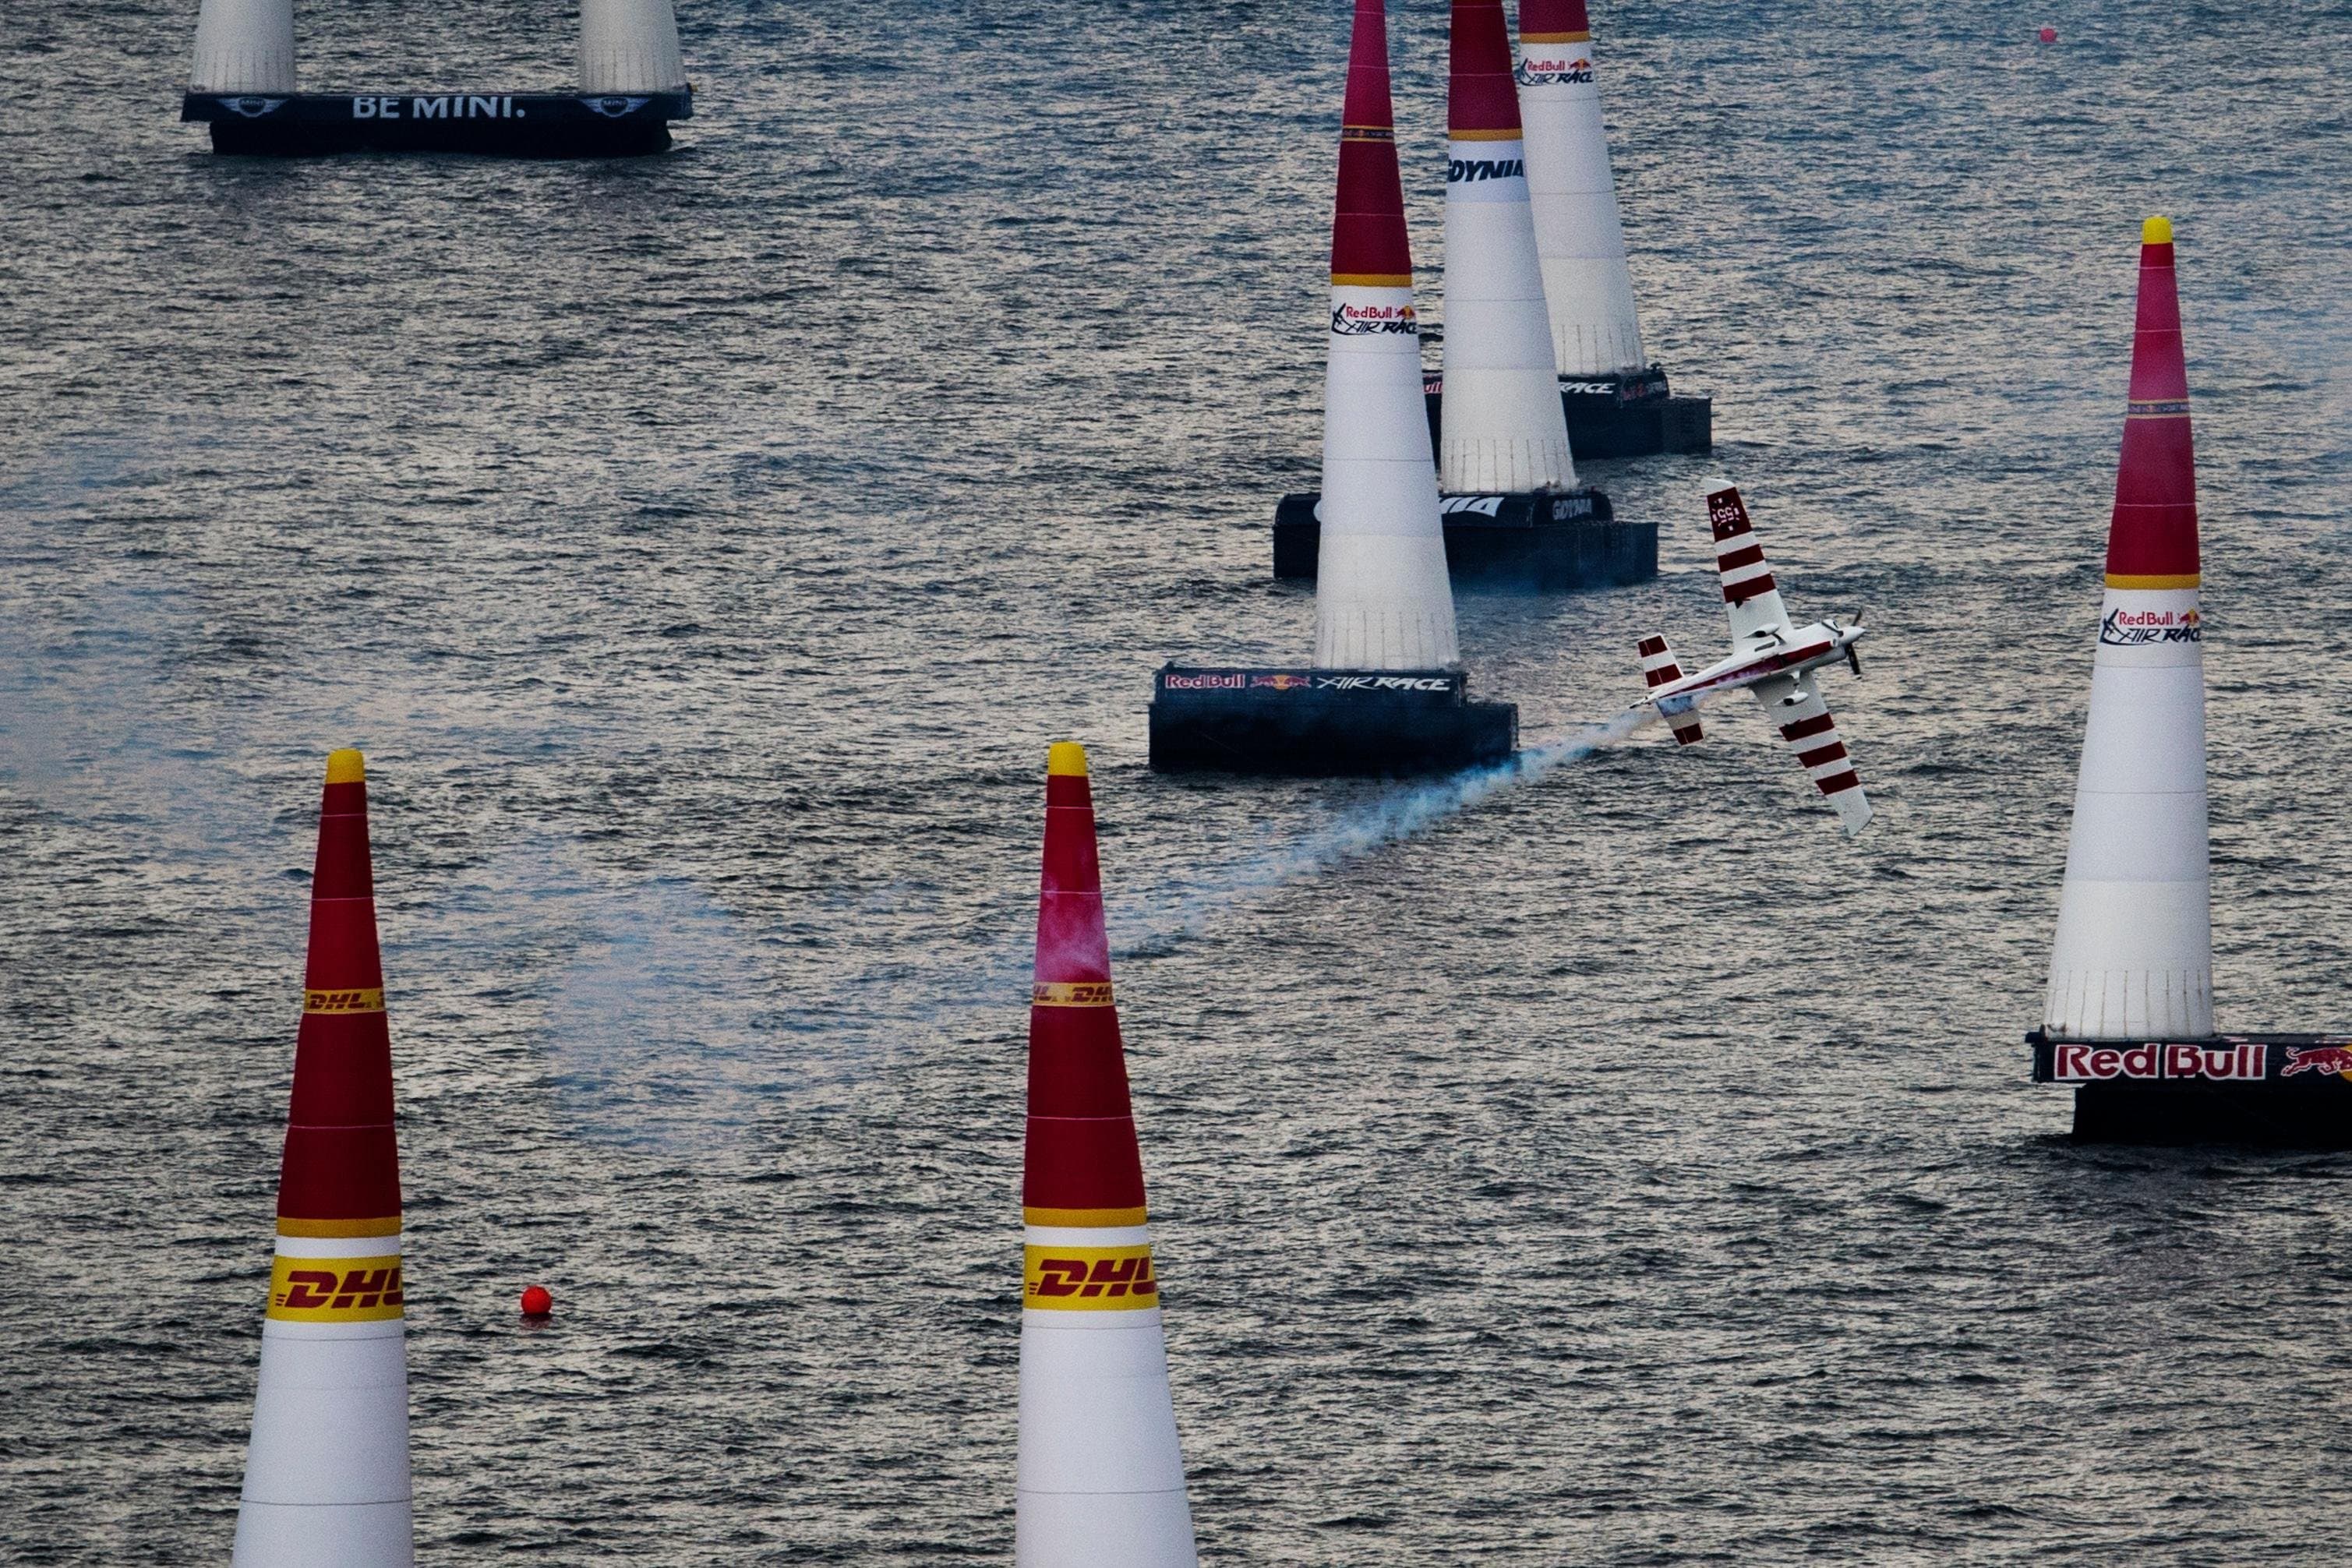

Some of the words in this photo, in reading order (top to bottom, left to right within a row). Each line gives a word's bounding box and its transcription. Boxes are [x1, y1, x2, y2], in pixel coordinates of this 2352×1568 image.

[352, 97, 401, 118] BE
[412, 96, 526, 118] MINI.
[1346, 306, 1368, 318] Red
[1369, 306, 1392, 319] Bull
[2119, 611, 2145, 625] Red
[2147, 611, 2174, 625] Bull
[1165, 674, 1206, 689] Red
[1207, 674, 1245, 689] Bull
[1374, 677, 1451, 691] RACE
[309, 993, 367, 1010] DHL
[2054, 1043, 2161, 1080] Red
[2164, 1044, 2268, 1080] Bull
[1037, 1255, 1157, 1298] DHL
